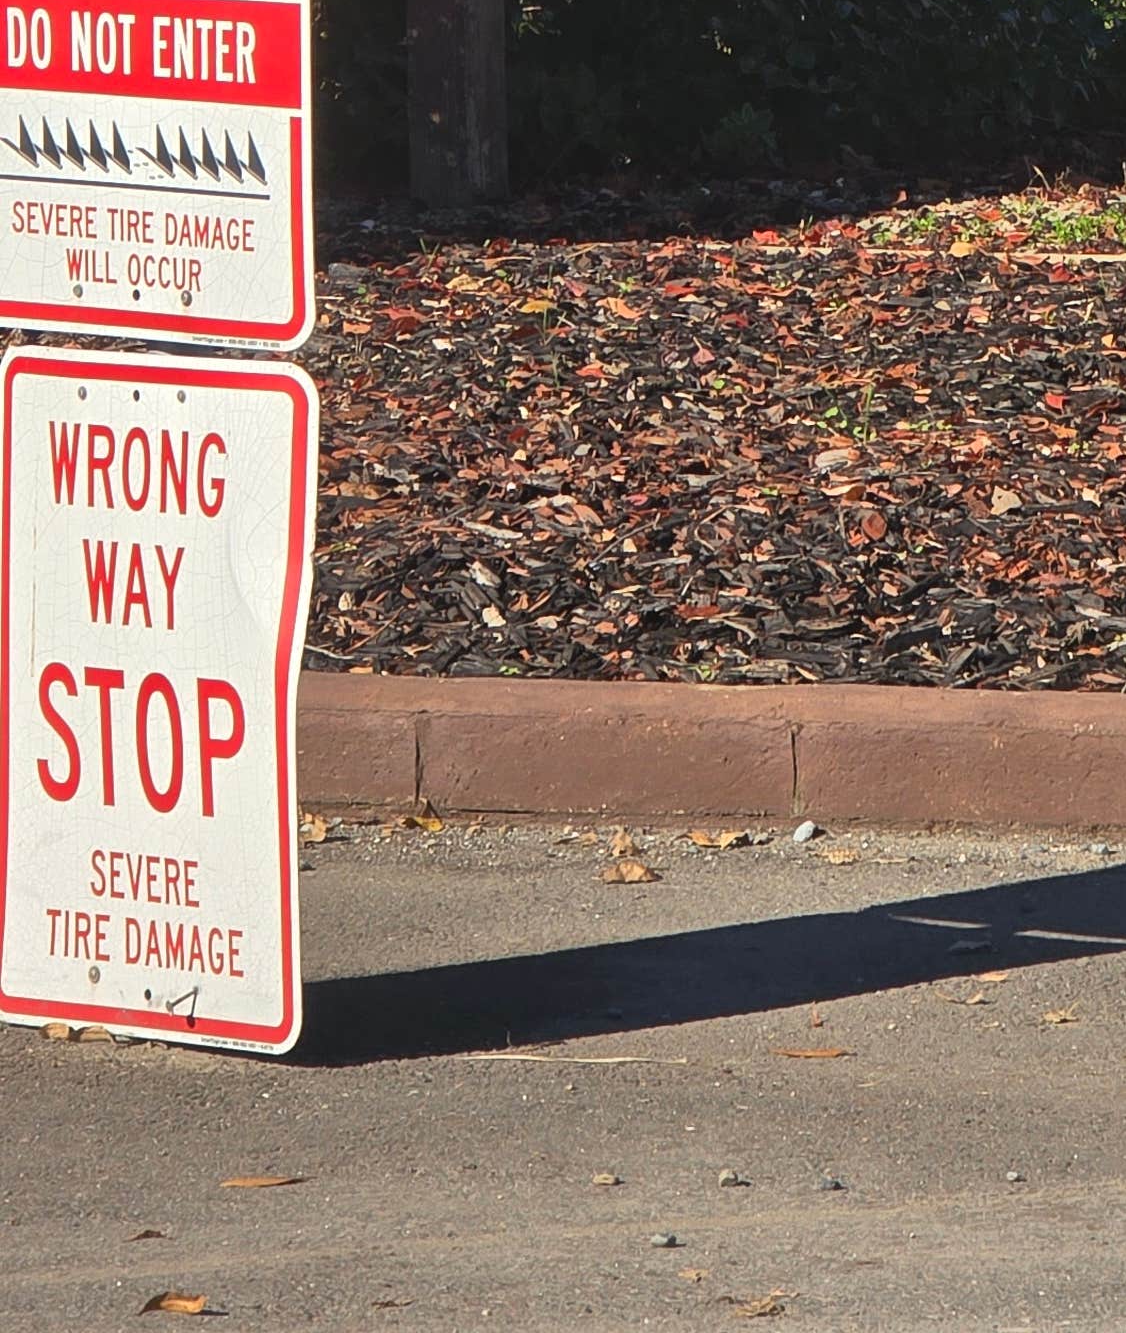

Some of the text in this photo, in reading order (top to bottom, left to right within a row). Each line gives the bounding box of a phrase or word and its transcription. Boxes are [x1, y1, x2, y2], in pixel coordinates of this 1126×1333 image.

[6, 6, 257, 84] DO NOT ENTER
[12, 201, 256, 252] SEVERE TIRE DAMAGE
[66, 248, 202, 292] WILL OCCUR
[49, 420, 228, 518] WRONG
[82, 538, 186, 631] WAY
[37, 662, 246, 817] STOP
[90, 849, 200, 908] SEVERE
[46, 908, 245, 978] TIRE DAMAGE
